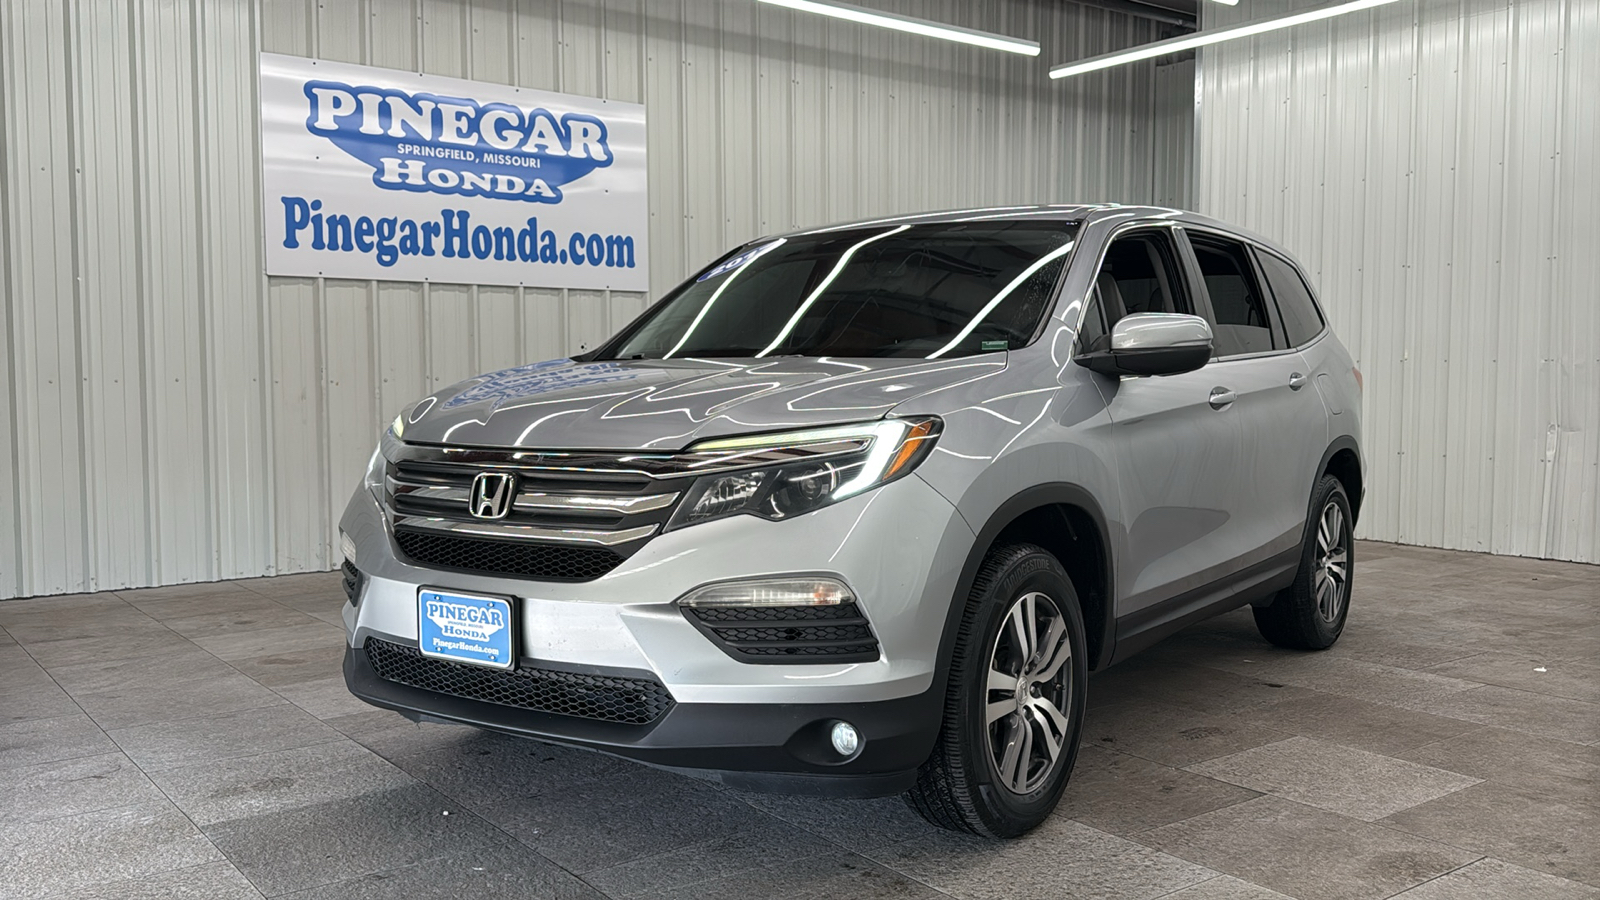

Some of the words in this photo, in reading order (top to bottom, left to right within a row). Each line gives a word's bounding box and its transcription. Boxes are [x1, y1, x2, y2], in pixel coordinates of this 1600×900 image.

[311, 87, 609, 162] PINEGAR
[397, 143, 480, 164] SPRINGFIELD,
[483, 152, 541, 169] MISSOURI
[379, 157, 557, 198] HONDA
[280, 196, 636, 268] PinegarHonda.com
[428, 603, 502, 627] PINEGAR
[443, 625, 488, 640] HONDA
[432, 637, 499, 655] PinegarHonda.com
